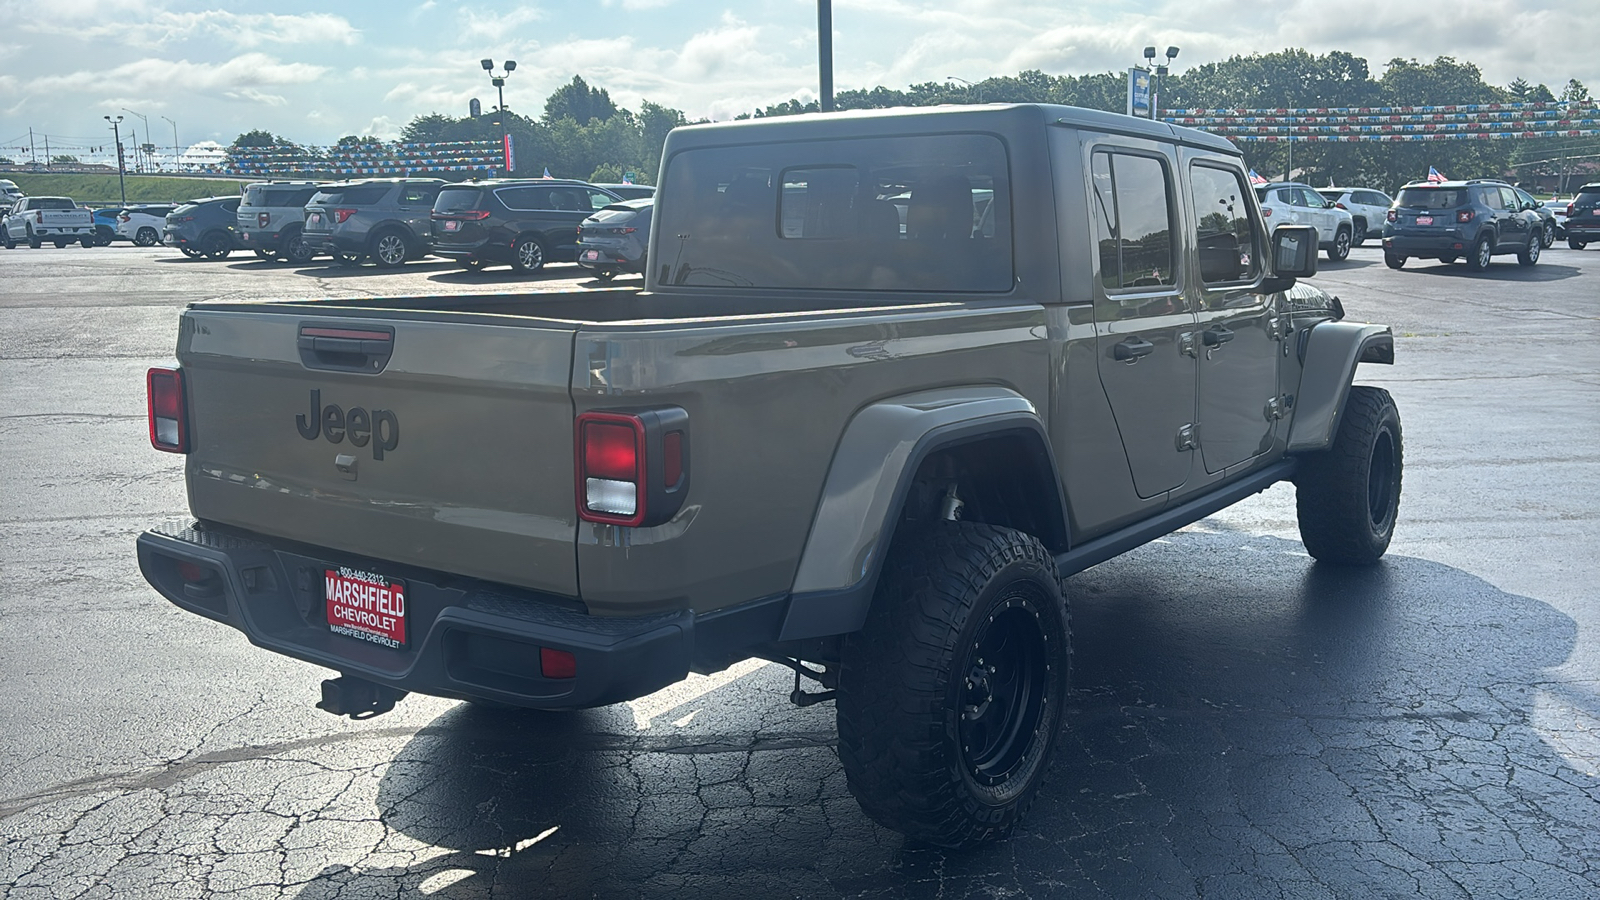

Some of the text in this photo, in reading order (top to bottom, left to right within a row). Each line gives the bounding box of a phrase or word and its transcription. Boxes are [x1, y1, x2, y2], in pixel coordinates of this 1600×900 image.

[295, 388, 399, 462] Jeep
[340, 566, 386, 587] 800-440-2312
[325, 576, 405, 618] MARSHFIELD
[333, 604, 397, 632] CHEVROLET
[330, 624, 400, 649] MARSHFIELD CHEVROLET
